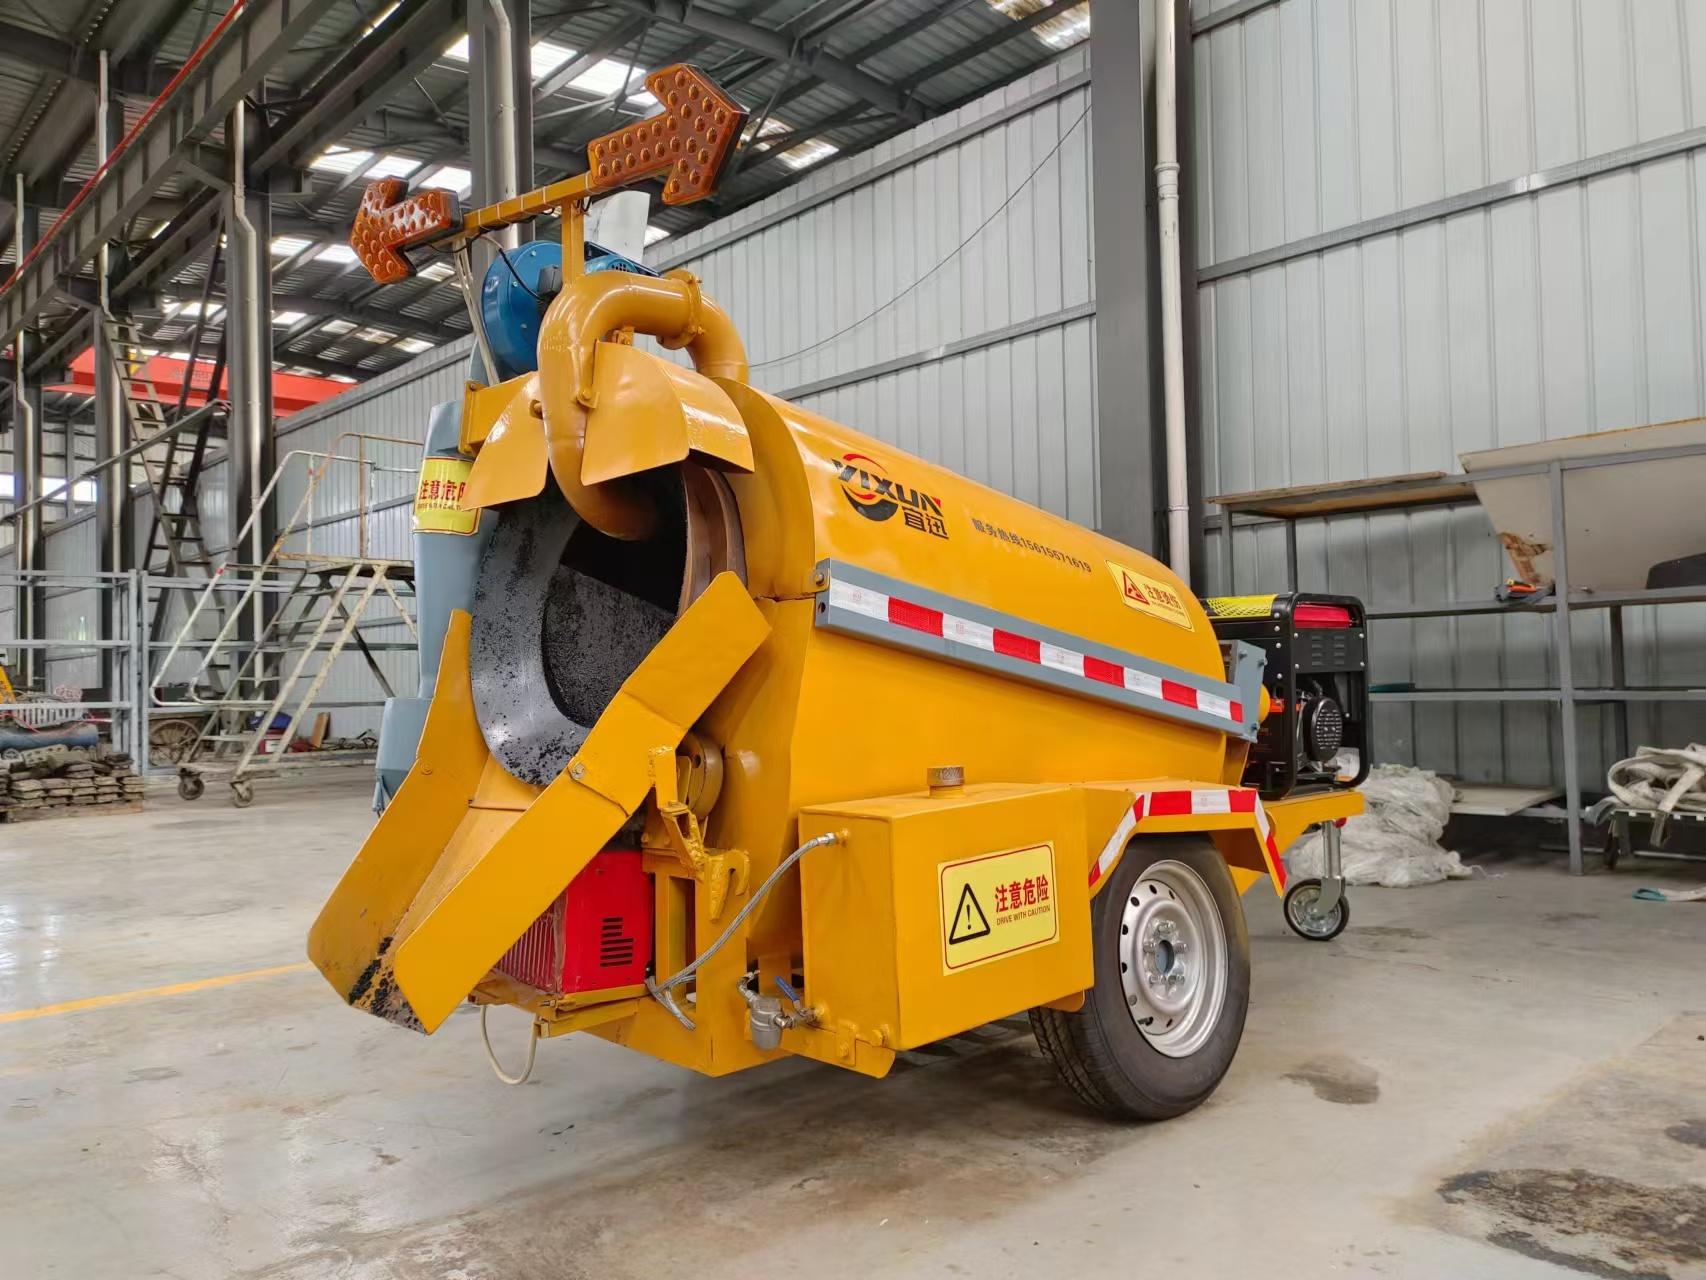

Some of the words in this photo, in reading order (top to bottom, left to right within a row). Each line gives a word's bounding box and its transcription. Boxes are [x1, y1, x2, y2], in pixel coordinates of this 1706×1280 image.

[418, 480, 466, 502] 注意危
[831, 459, 944, 518] YIXUN
[902, 506, 949, 540] 宜迅
[995, 874, 1049, 913] 注意危险
[996, 914, 1013, 926] DRIVE
[1013, 910, 1027, 921] WITH
[1027, 904, 1051, 917] CAUTION
